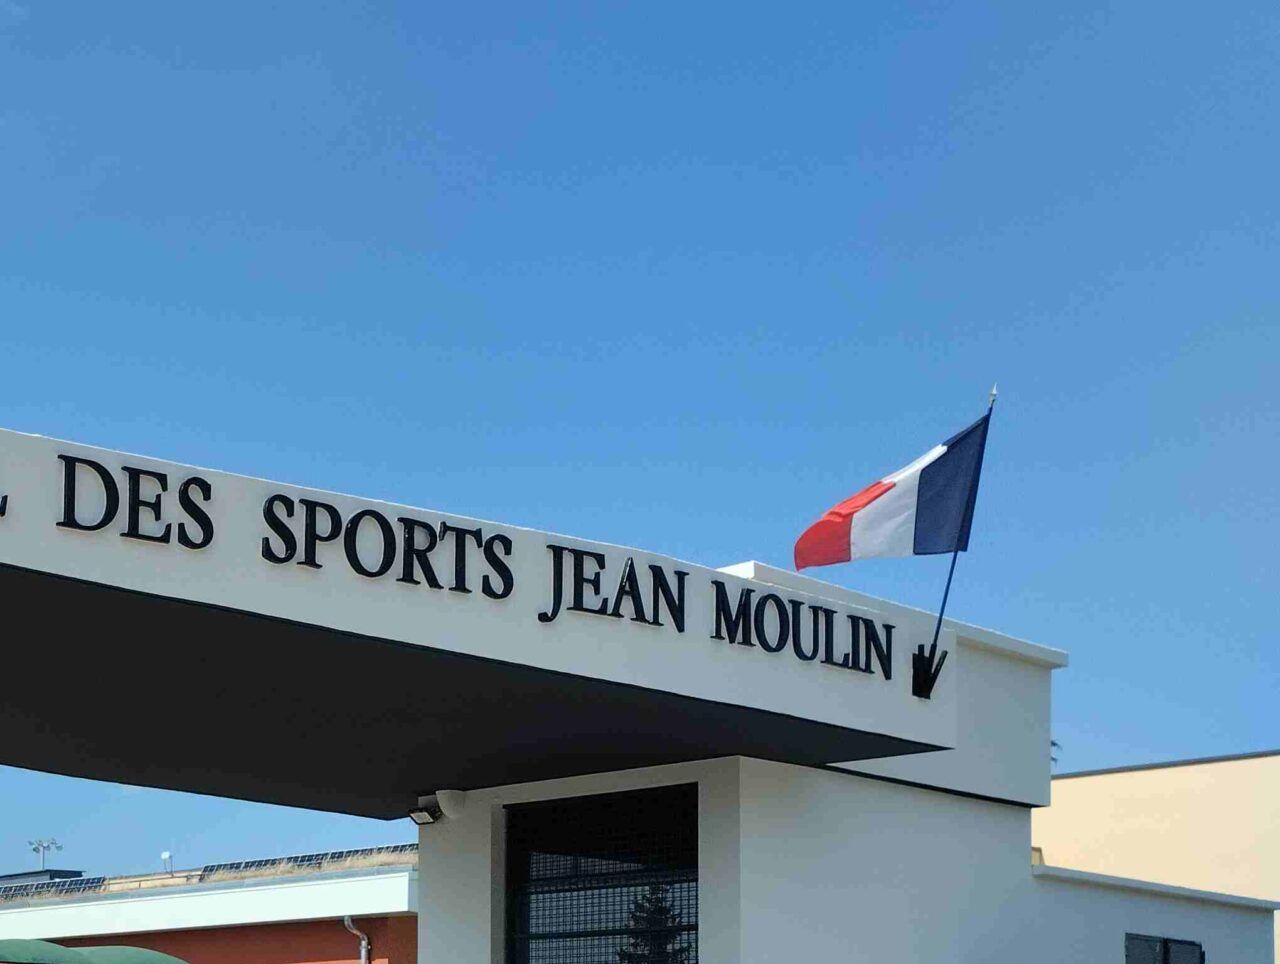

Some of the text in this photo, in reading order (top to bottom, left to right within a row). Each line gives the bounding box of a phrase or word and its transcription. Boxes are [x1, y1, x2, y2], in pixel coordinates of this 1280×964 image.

[56, 454, 213, 549] DES
[262, 494, 513, 599] SPORTS
[538, 545, 689, 633] JEAN
[710, 580, 895, 680] MOULIN
